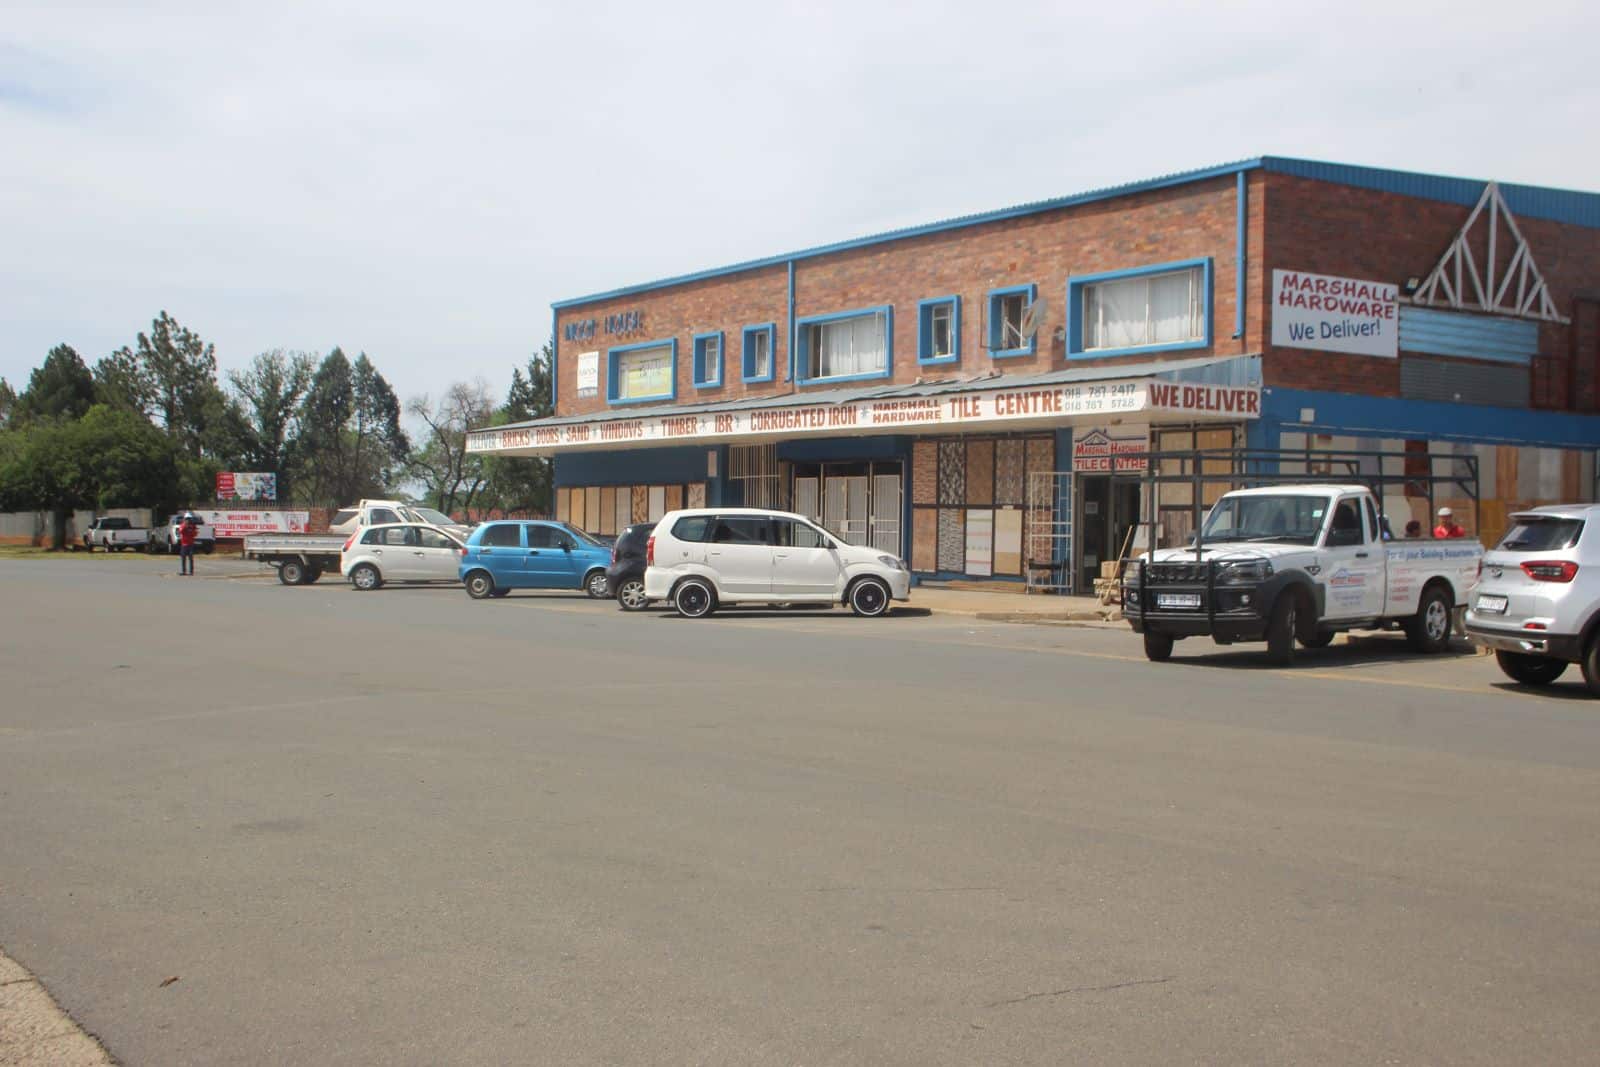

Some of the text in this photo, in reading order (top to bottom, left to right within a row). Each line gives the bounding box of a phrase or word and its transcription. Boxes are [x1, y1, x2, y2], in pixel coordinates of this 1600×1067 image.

[1282, 274, 1394, 303] MARSHALL
[1279, 291, 1394, 319] HARDWARE
[1289, 319, 1381, 341] We Deliver!
[949, 388, 1064, 418] TILE CENTRE
[1065, 383, 1136, 399] 018 787 2417
[1150, 383, 1259, 413] WE DELIVER
[873, 399, 940, 411] MARSHALL
[873, 410, 942, 423] HARDWARE
[502, 429, 530, 448] BRICKS
[536, 427, 559, 445] DOORS
[566, 424, 590, 443] SAND
[600, 420, 643, 440] WINDOWS
[661, 416, 698, 437] TIMBER
[714, 414, 733, 433] IBR
[750, 407, 825, 431] CORRUGATED
[828, 405, 857, 426] IRON
[1074, 459, 1097, 470] TILE
